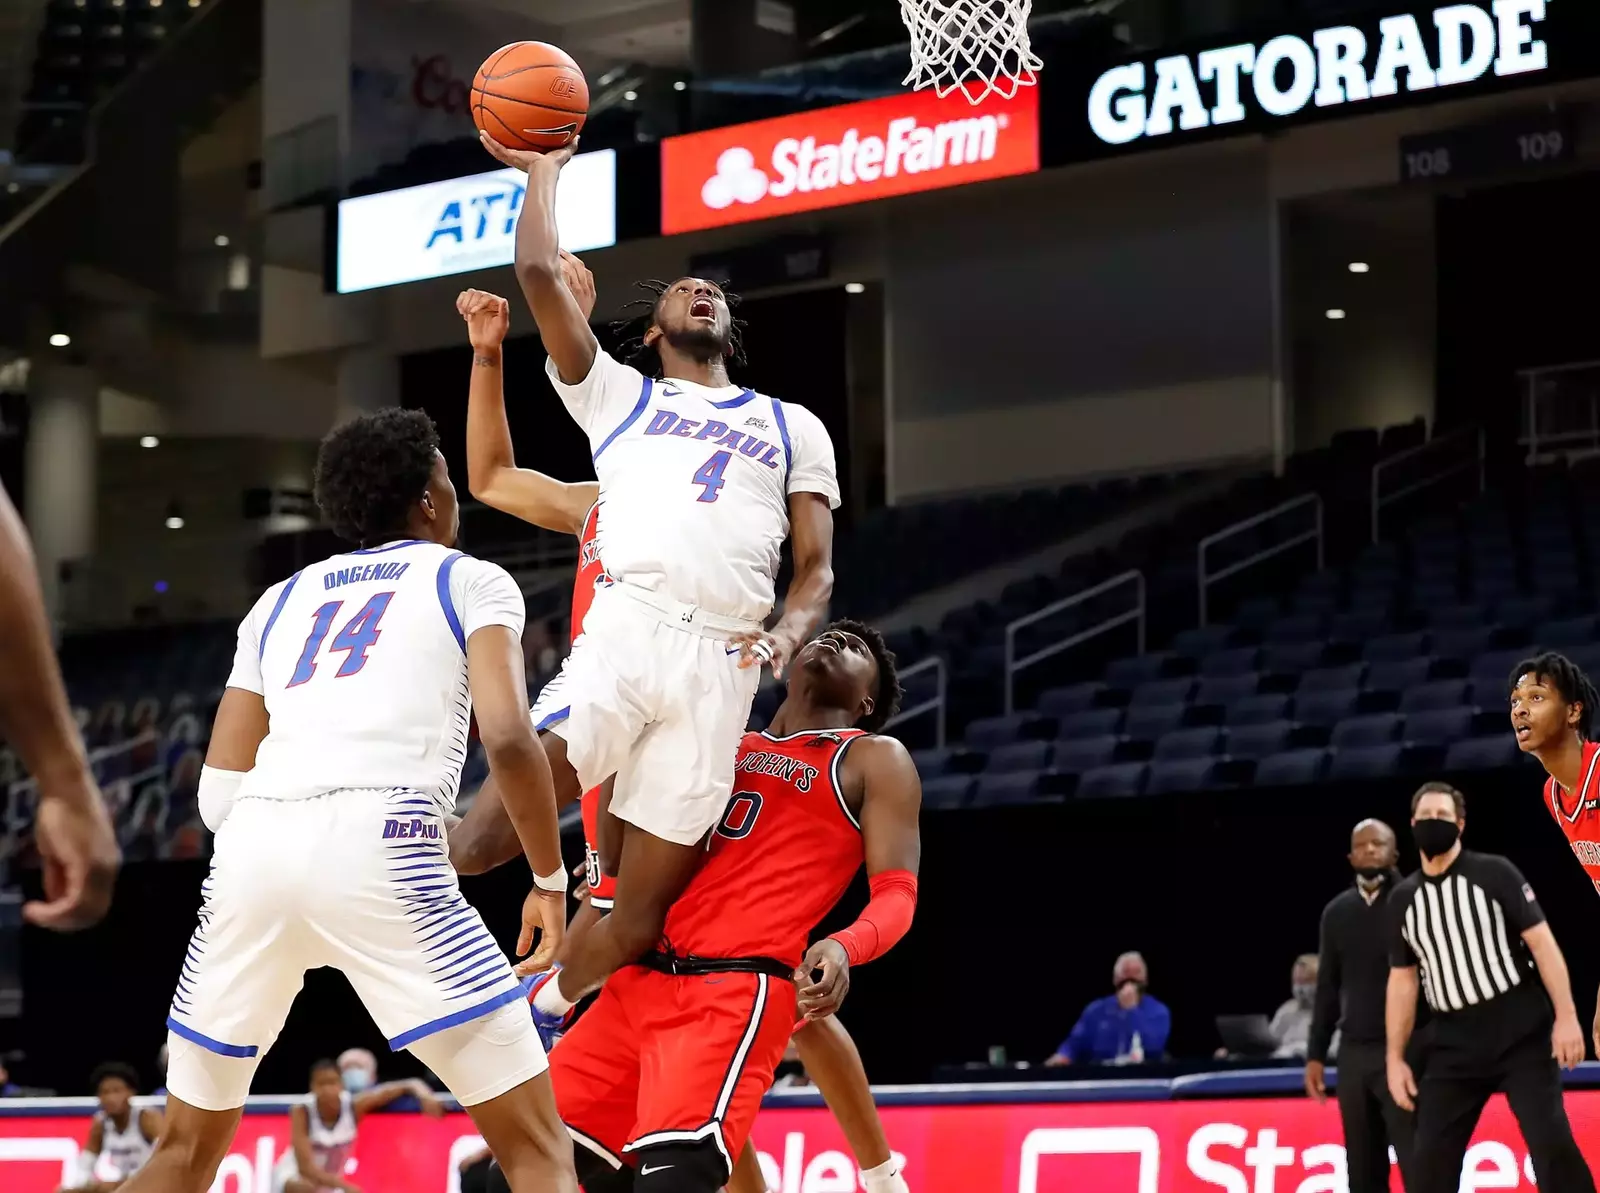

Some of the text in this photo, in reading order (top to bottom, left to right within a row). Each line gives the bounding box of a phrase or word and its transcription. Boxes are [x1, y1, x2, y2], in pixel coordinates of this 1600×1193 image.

[1088, 0, 1548, 144] GATORADE
[1405, 130, 1563, 179] 108 109
[692, 450, 732, 503] 4
[324, 562, 410, 590] ONGENDA
[285, 591, 396, 689] 14
